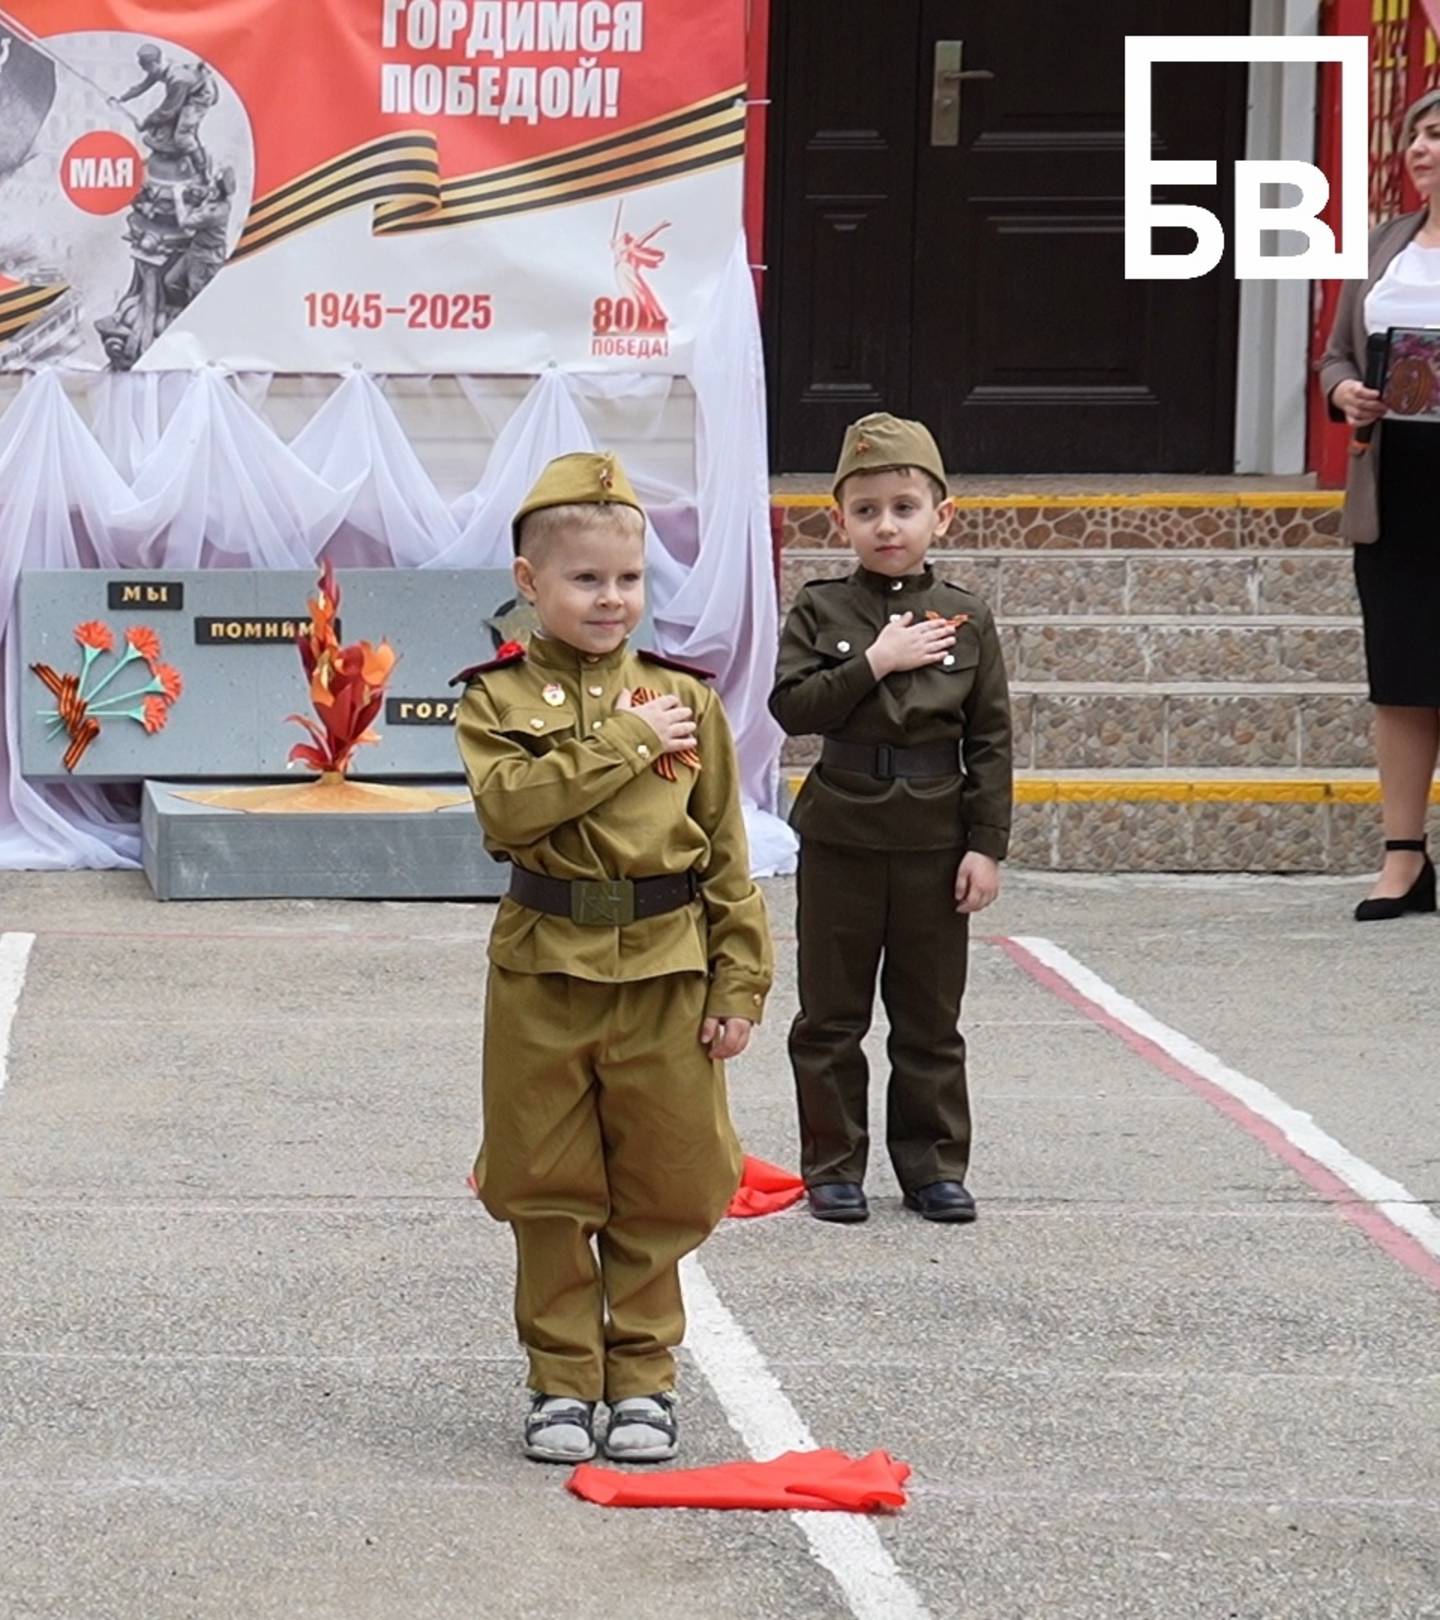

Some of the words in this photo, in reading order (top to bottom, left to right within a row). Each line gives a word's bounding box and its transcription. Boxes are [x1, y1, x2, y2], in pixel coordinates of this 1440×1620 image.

[382, 0, 643, 58] ГОРДИМСЯ
[381, 57, 620, 125] ПОБЕДОЙ!
[70, 157, 134, 188] МАЯ
[593, 296, 636, 333] 80
[591, 338, 669, 358] ПОБЕДА!
[121, 585, 168, 602] МЫ
